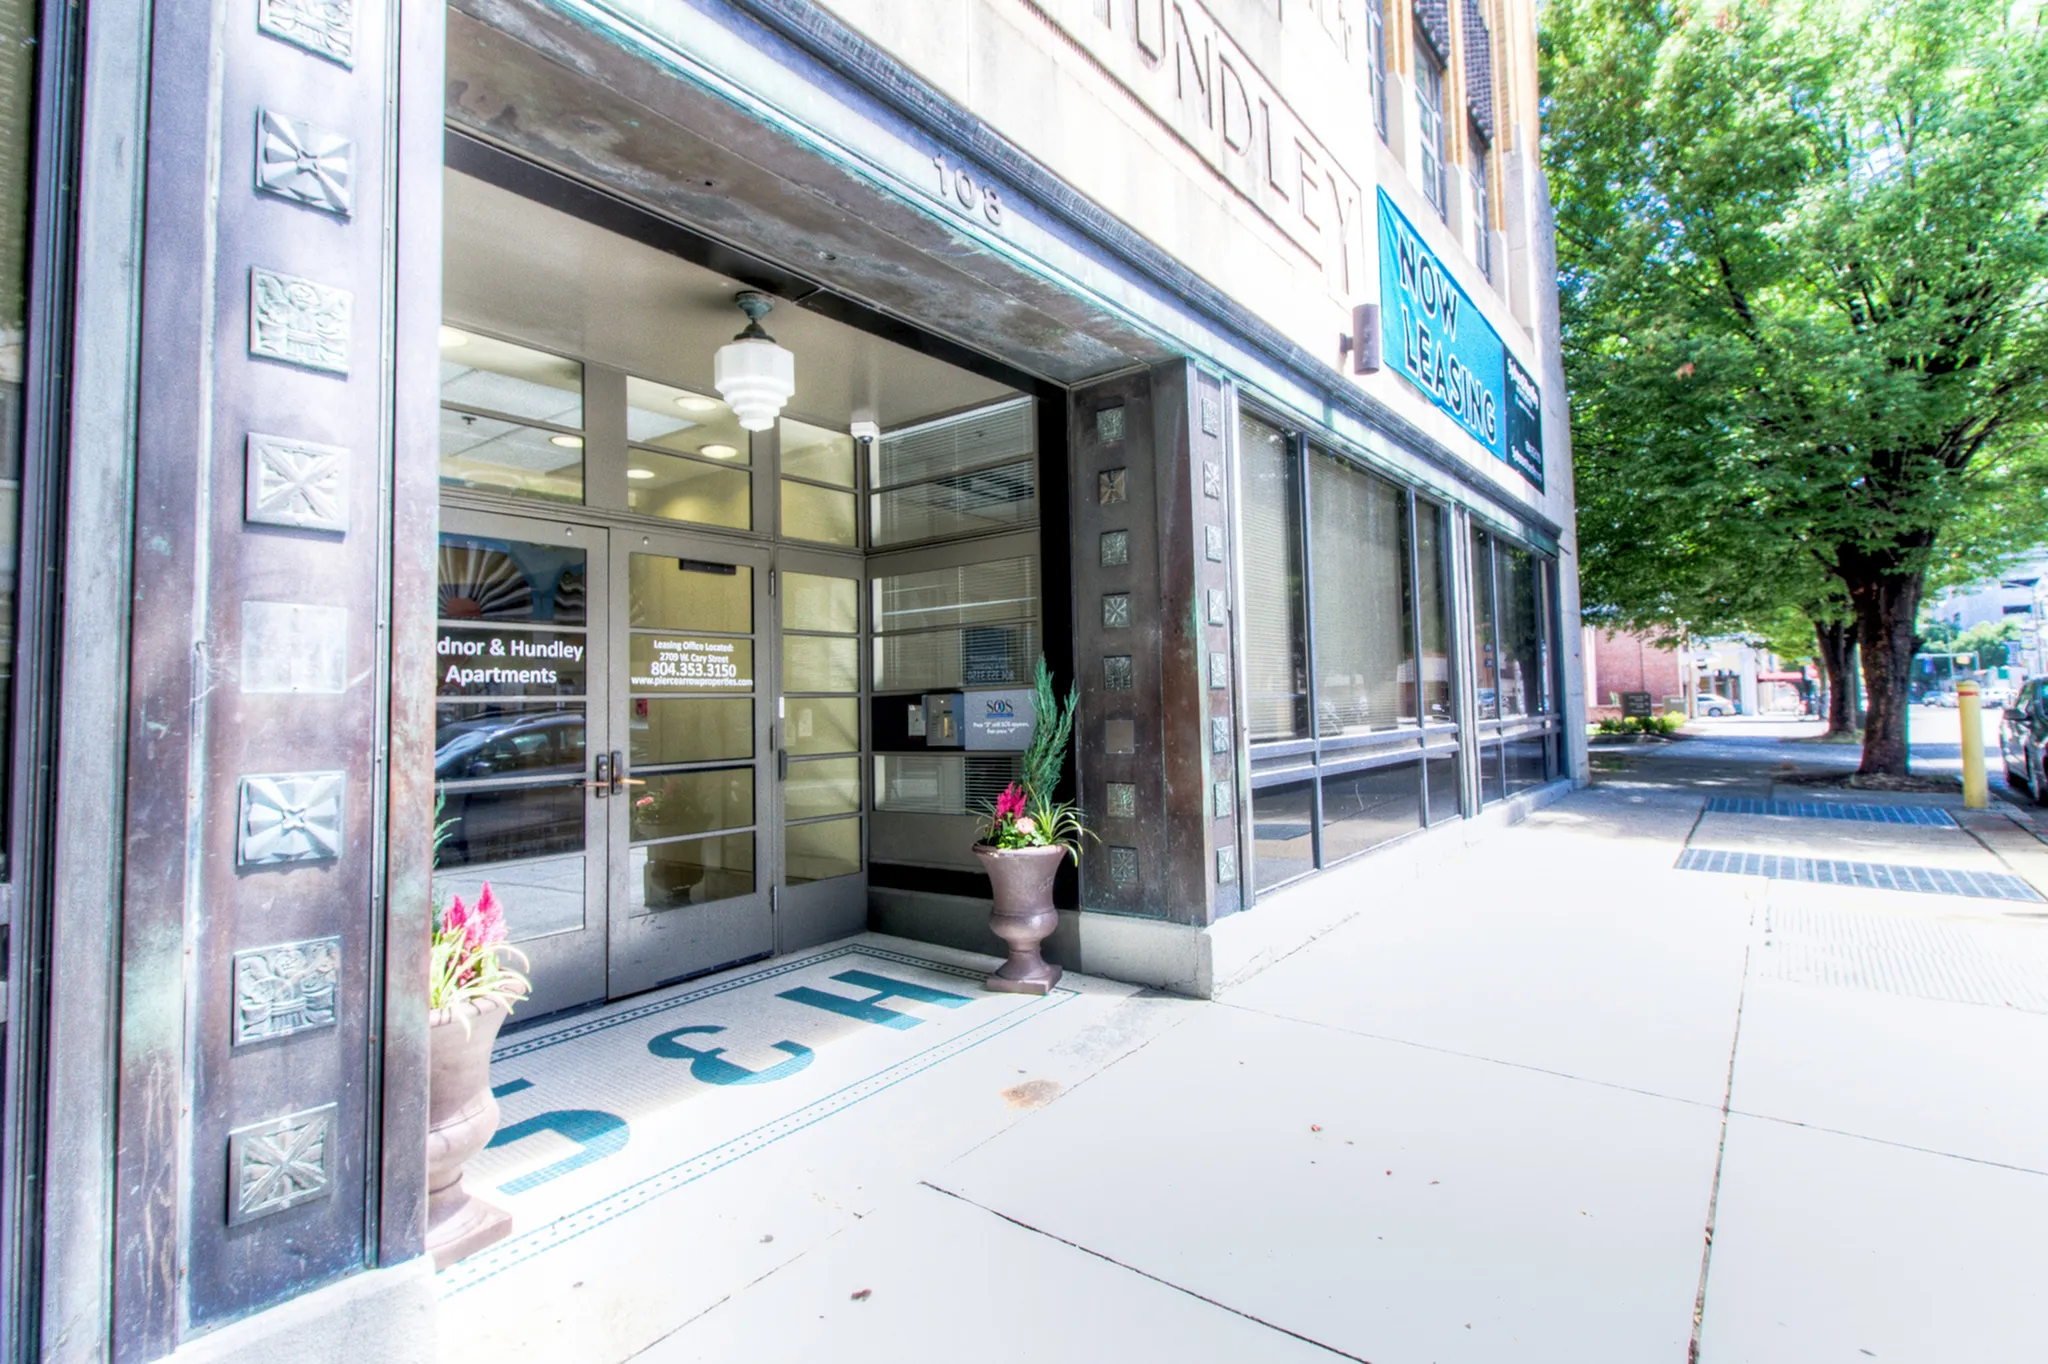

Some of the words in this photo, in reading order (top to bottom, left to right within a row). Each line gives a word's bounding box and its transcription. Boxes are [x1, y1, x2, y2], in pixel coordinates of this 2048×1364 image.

[1092, 0, 1351, 296] UNDLEY
[933, 153, 1002, 227] 108
[1397, 219, 1459, 342] NOW
[1401, 303, 1497, 445] LEASING
[436, 636, 485, 655] dnor
[489, 638, 506, 656] &
[510, 639, 584, 662] Hundley
[653, 640, 682, 651] Leasing
[682, 641, 704, 651] Office
[705, 643, 733, 652] Located:
[659, 652, 679, 662] 2709
[690, 654, 707, 664] Cary
[707, 655, 729, 663] Street
[445, 664, 558, 687] Apartments
[651, 662, 736, 677] 804.353.3150
[986, 699, 1014, 713] SOS
[774, 969, 977, 1032] H
